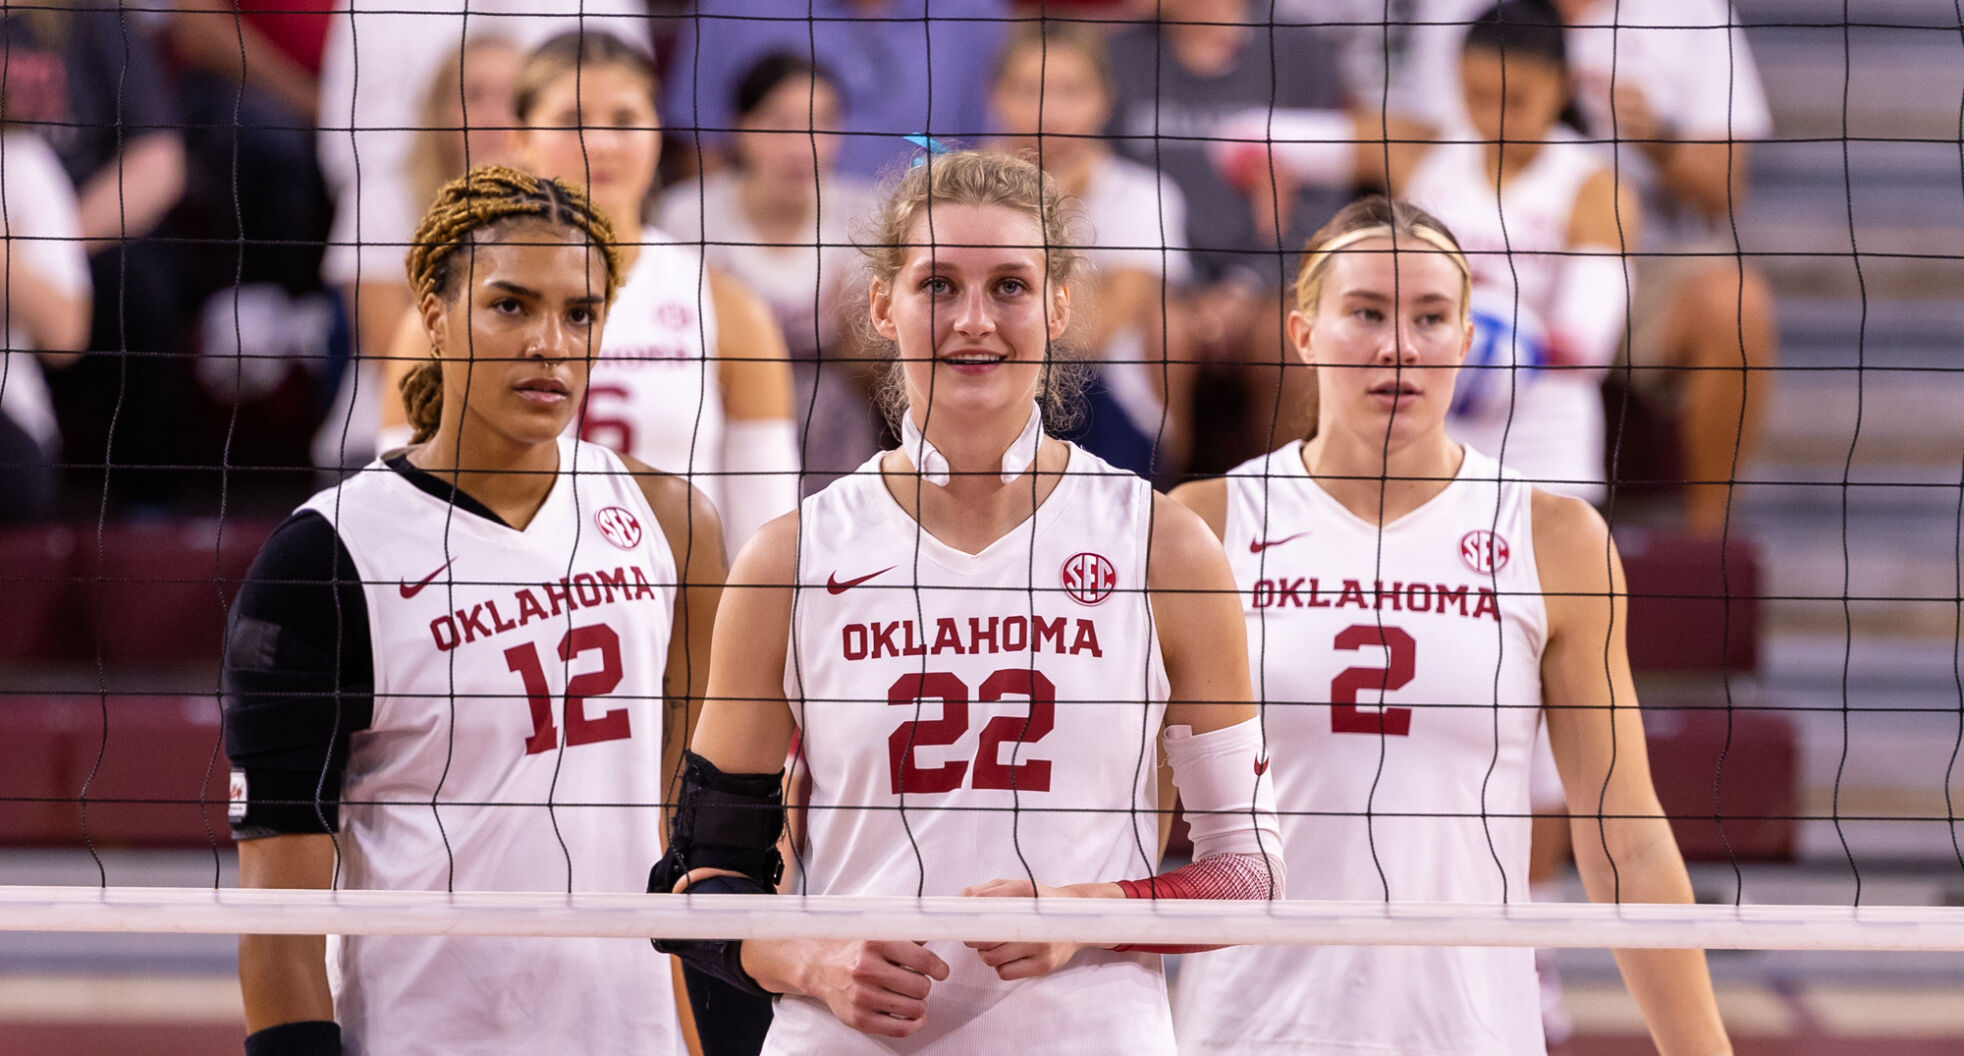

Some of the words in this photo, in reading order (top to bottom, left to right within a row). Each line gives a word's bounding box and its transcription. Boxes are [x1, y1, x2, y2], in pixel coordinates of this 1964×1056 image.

[597, 507, 641, 549] SEC
[1460, 530, 1509, 574] SEC
[1063, 553, 1115, 603] SEC
[1251, 577, 1502, 622] OKLAHOMA
[429, 566, 655, 652] OKLAHOMA
[842, 615, 1103, 661] OKLAHOMA
[503, 622, 632, 756] 12
[1330, 623, 1417, 737] 2
[887, 668, 1056, 795] 22
